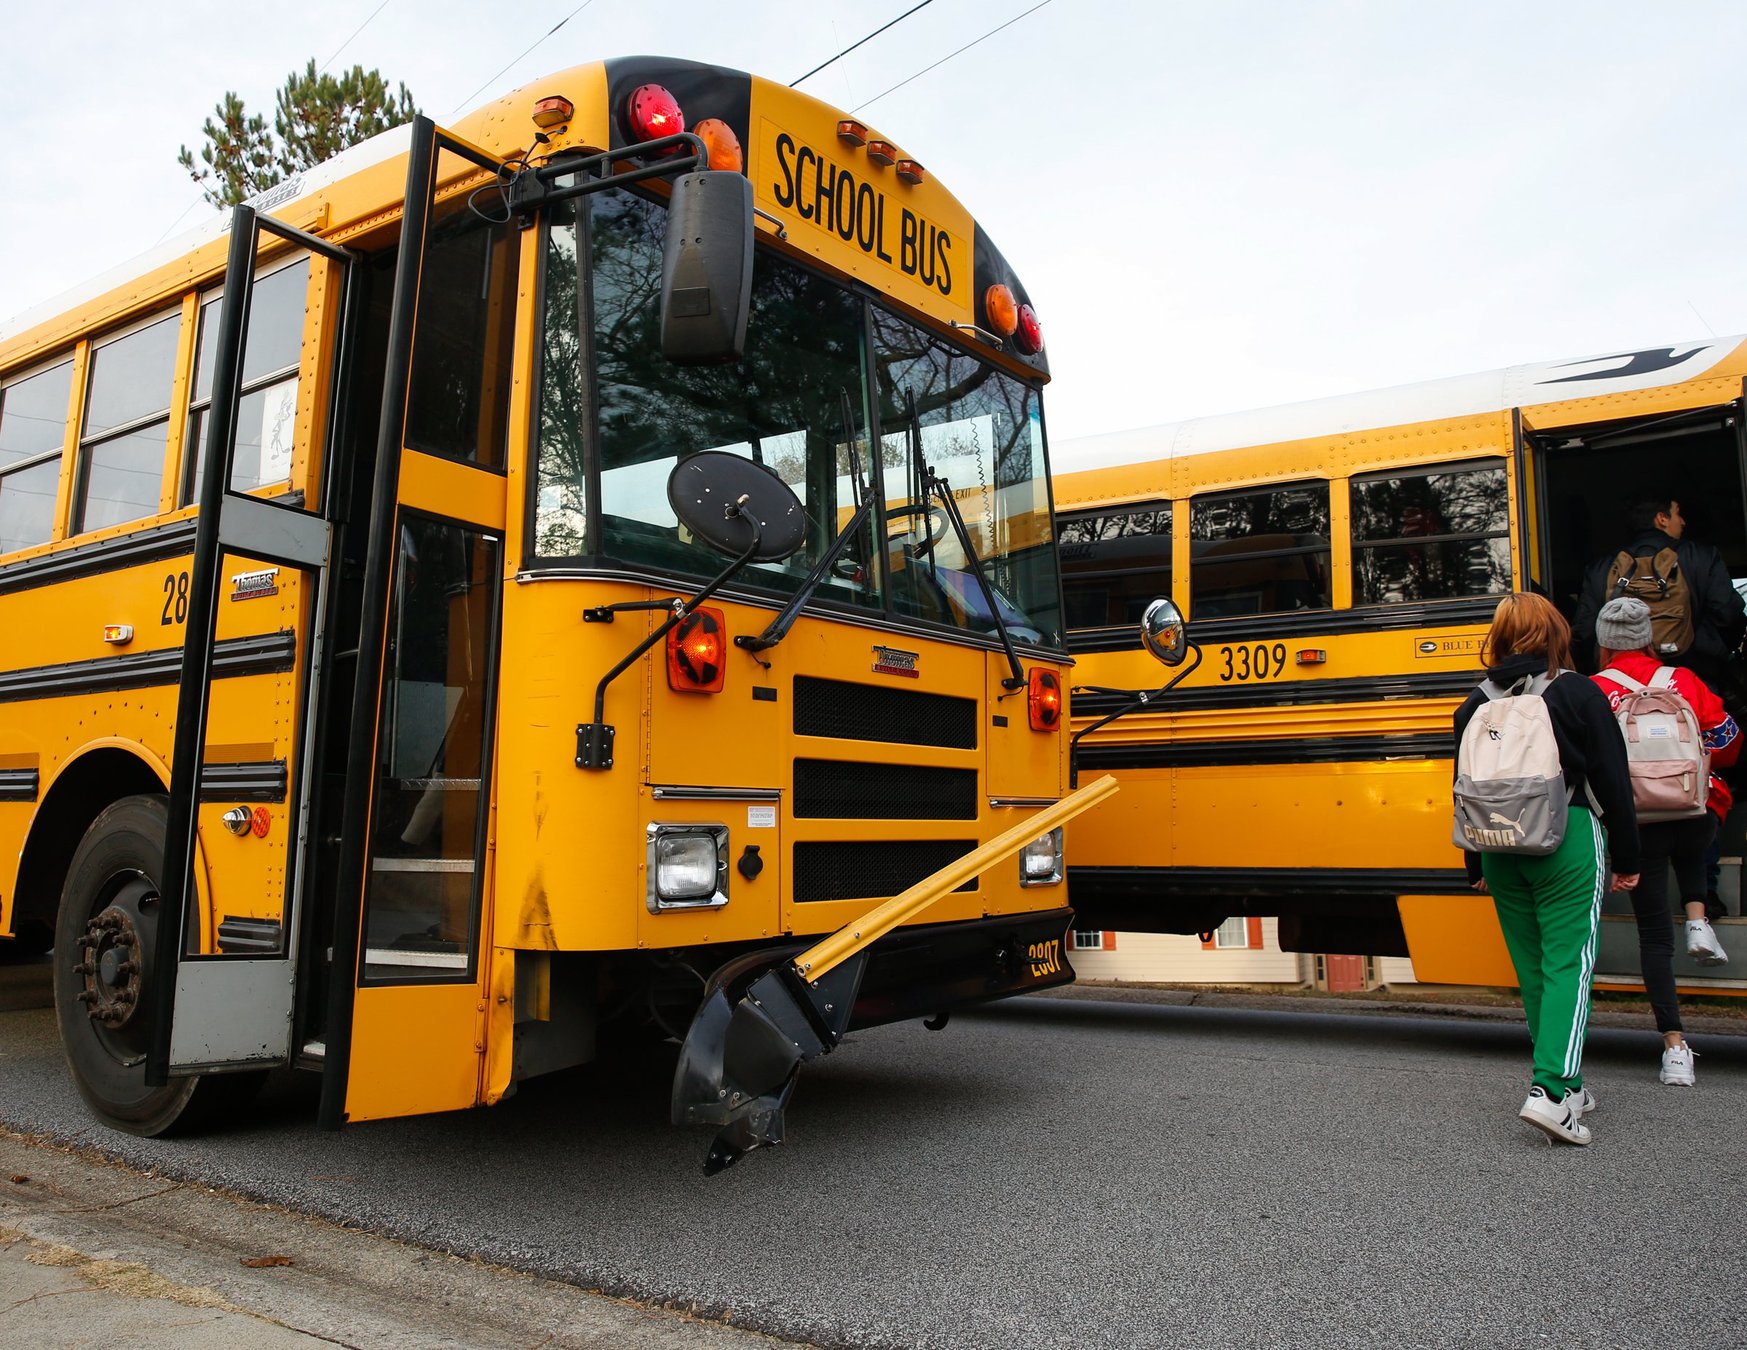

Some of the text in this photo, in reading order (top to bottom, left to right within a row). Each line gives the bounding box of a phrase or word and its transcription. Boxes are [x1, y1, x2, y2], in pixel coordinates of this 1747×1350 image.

[773, 132, 952, 296] SCHOOL BUS
[955, 487, 971, 500] EXIT
[231, 568, 280, 593] Thomas
[161, 571, 189, 626] 28
[1442, 640, 1473, 651] BLUE
[1219, 643, 1287, 682] 3309
[1464, 824, 1516, 847] PUMA
[1029, 939, 1061, 977] 2807
